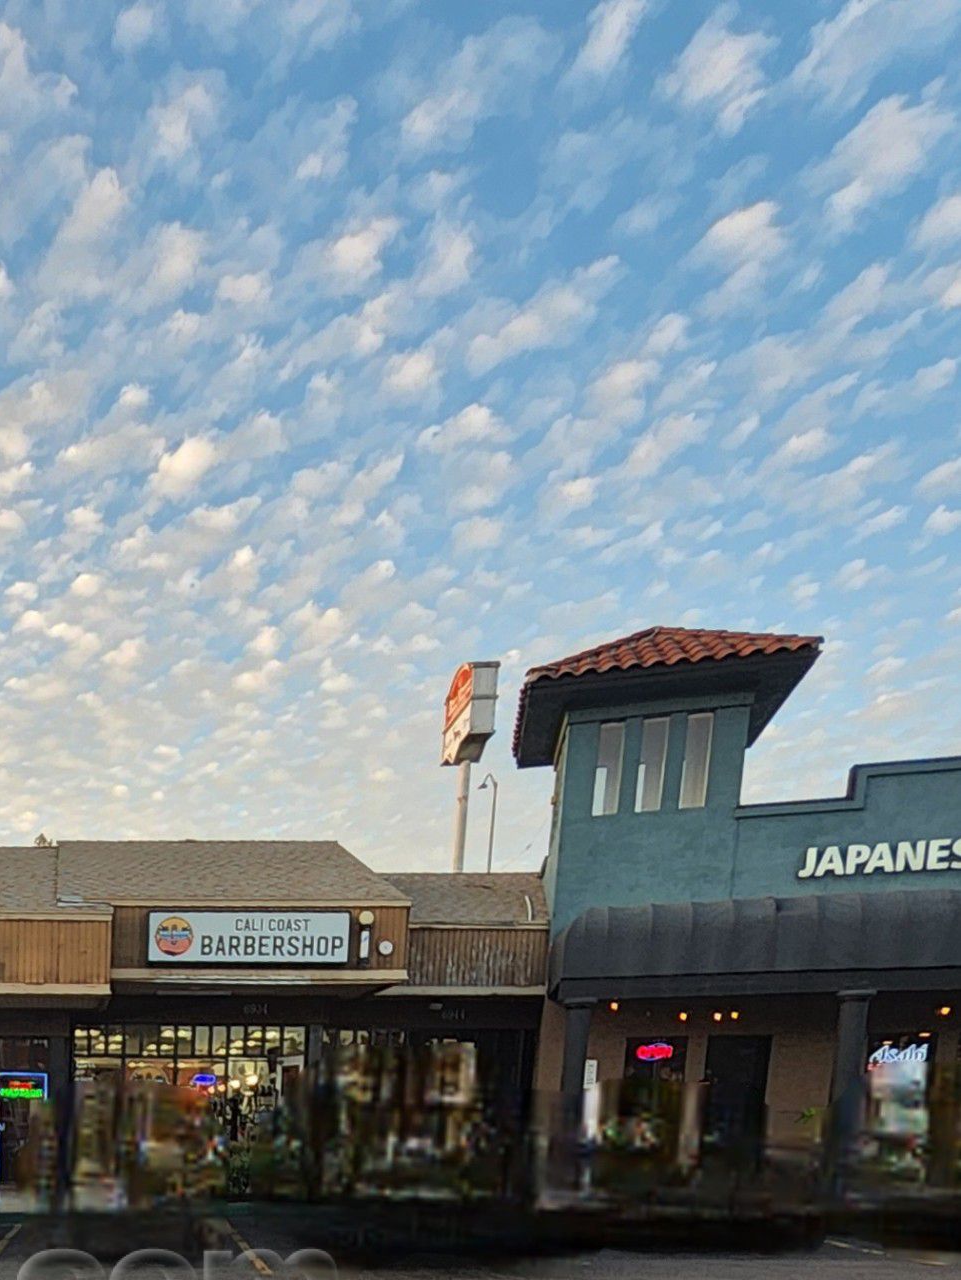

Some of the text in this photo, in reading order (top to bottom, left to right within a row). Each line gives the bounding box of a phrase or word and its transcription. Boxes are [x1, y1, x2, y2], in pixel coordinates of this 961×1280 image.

[235, 919, 311, 931] CALI COAST
[201, 935, 344, 956] BARBERSHOP
